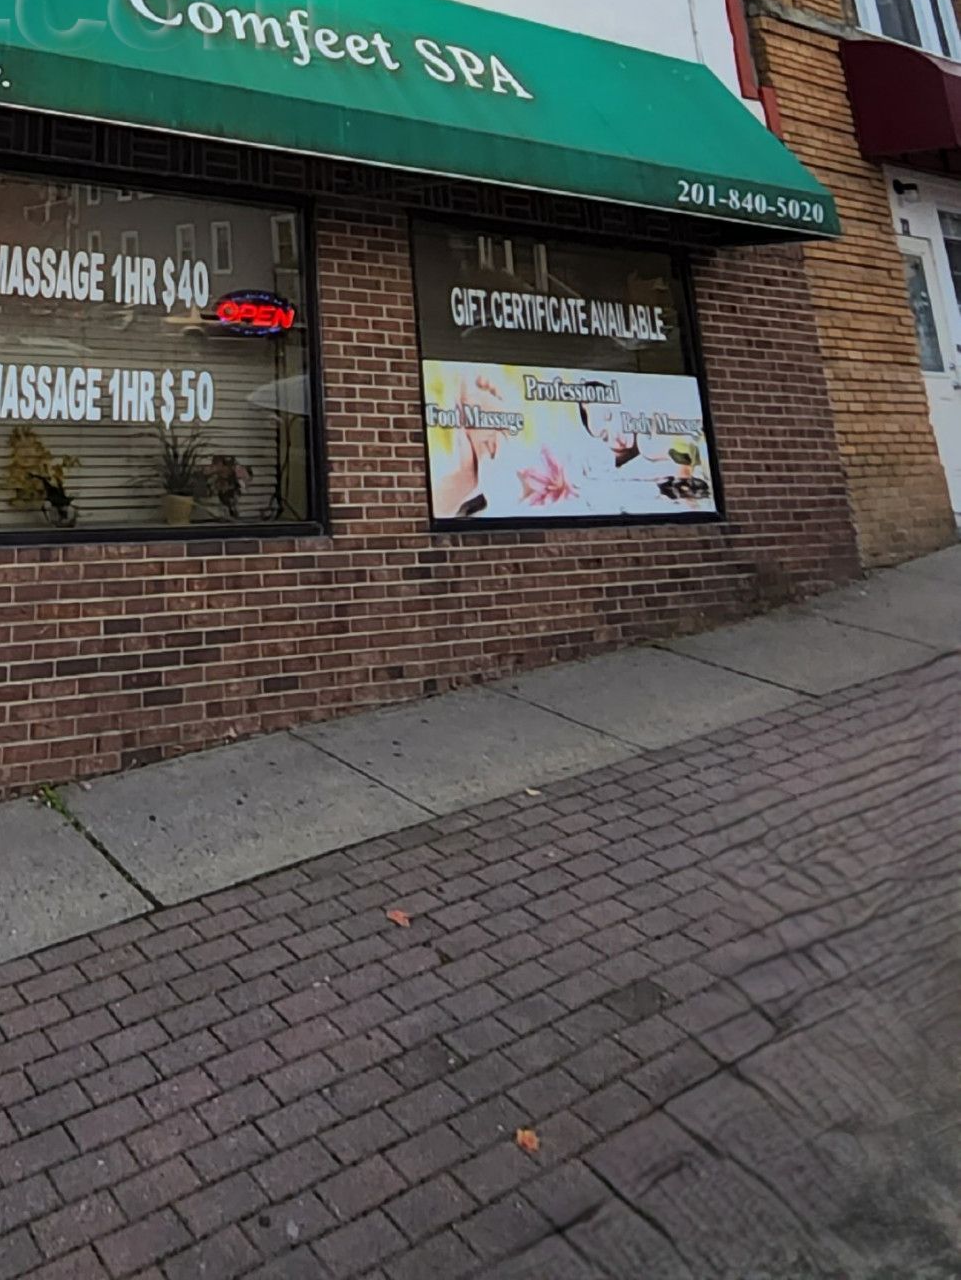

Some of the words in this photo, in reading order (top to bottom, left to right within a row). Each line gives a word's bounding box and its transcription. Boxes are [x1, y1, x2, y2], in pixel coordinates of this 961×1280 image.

[415, 37, 534, 100] SPA
[677, 180, 825, 224] 201-840-5020
[111, 254, 157, 306] 1HR
[162, 257, 209, 313] $40
[216, 300, 295, 330] OPEN
[451, 287, 487, 326] GIFT
[490, 291, 589, 335] CERTIFICATE
[590, 300, 666, 341] AVAILABLE
[108, 369, 155, 422] 1HR
[524, 375, 621, 404] Professional
[426, 404, 462, 428] Foot
[462, 405, 524, 435] Massage
